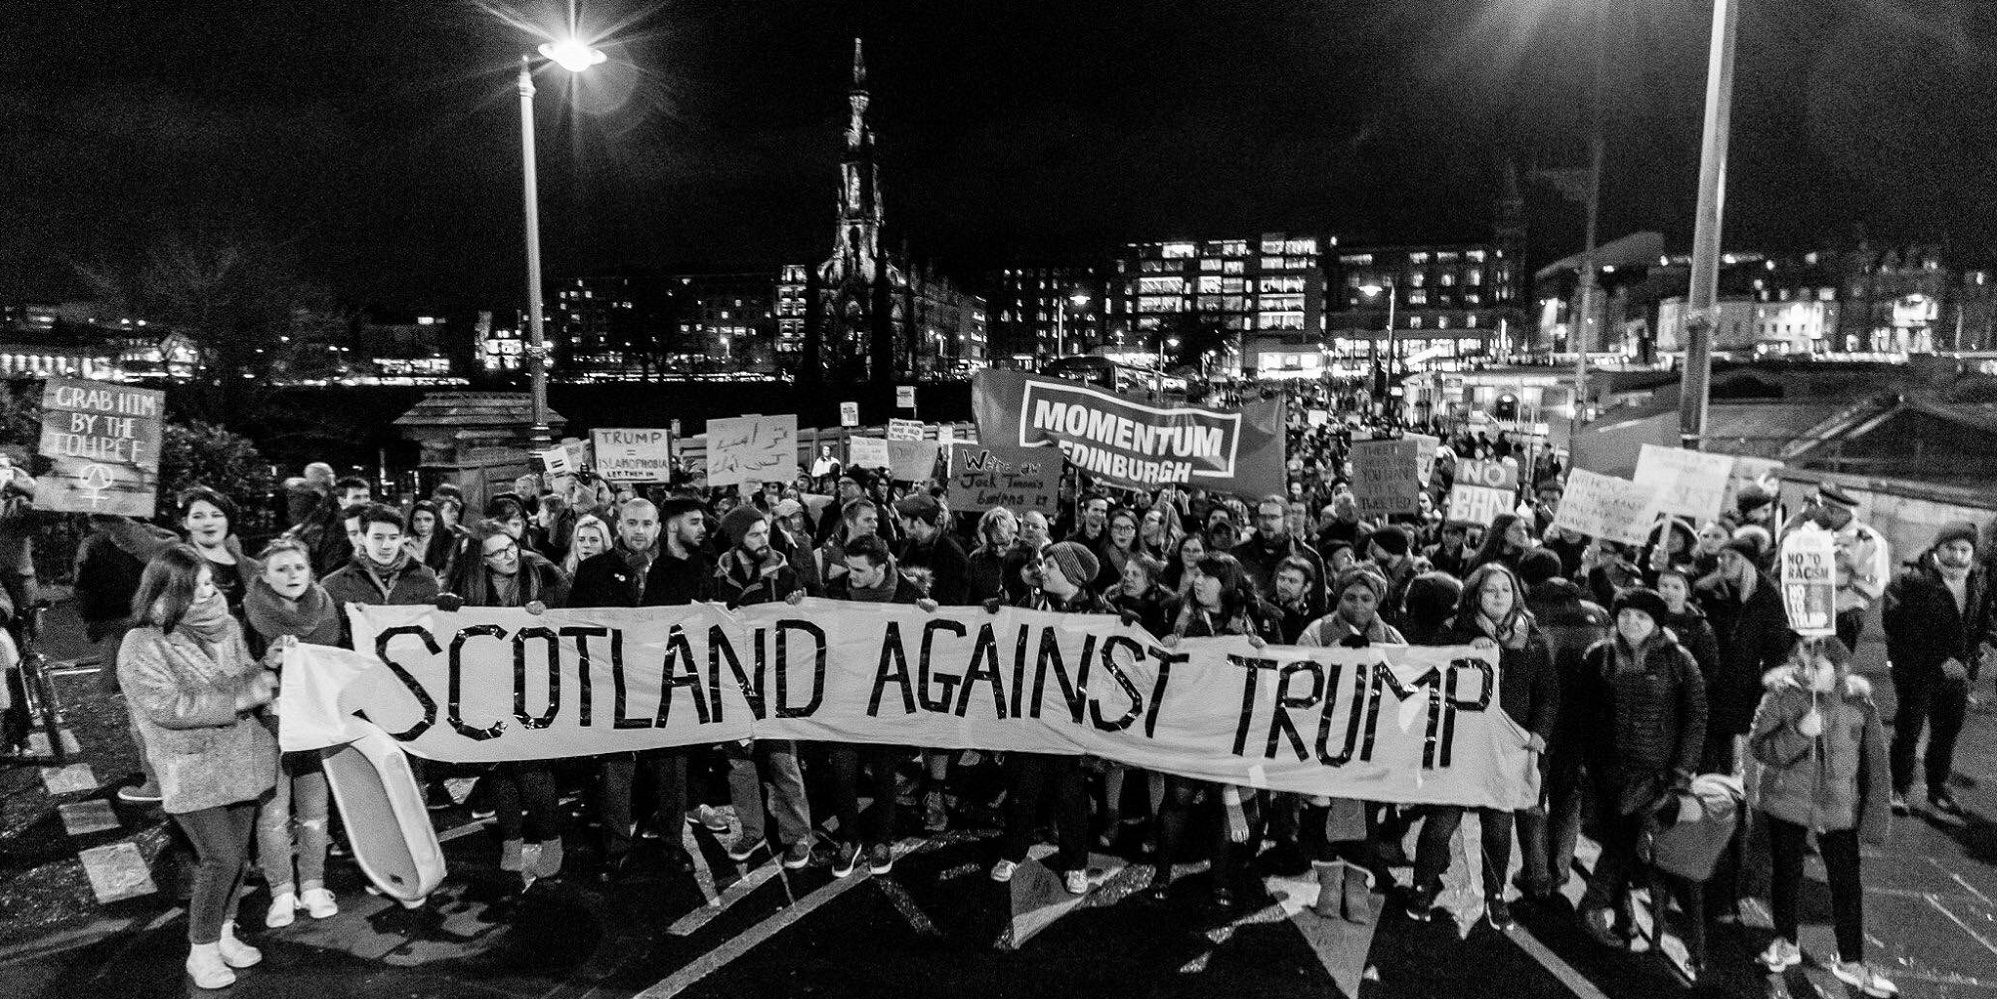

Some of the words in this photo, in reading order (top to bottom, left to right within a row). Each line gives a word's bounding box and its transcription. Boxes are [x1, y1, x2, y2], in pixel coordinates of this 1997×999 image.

[55, 387, 113, 411] GRAB
[118, 391, 157, 415] HIM
[71, 412, 97, 435] BY
[106, 415, 136, 439] THE
[601, 431, 662, 445] TRUMP
[1033, 399, 1224, 457] MOMENTUM
[1058, 439, 1192, 484] EDINBURGH
[1463, 460, 1506, 487] NO
[1787, 552, 1804, 565] NO
[1807, 552, 1821, 565] TO
[1787, 566, 1829, 580] RACISM
[351, 619, 827, 742] SCOTLAND
[867, 618, 1190, 738] AGAINST
[1227, 653, 1494, 769] TRUMP
